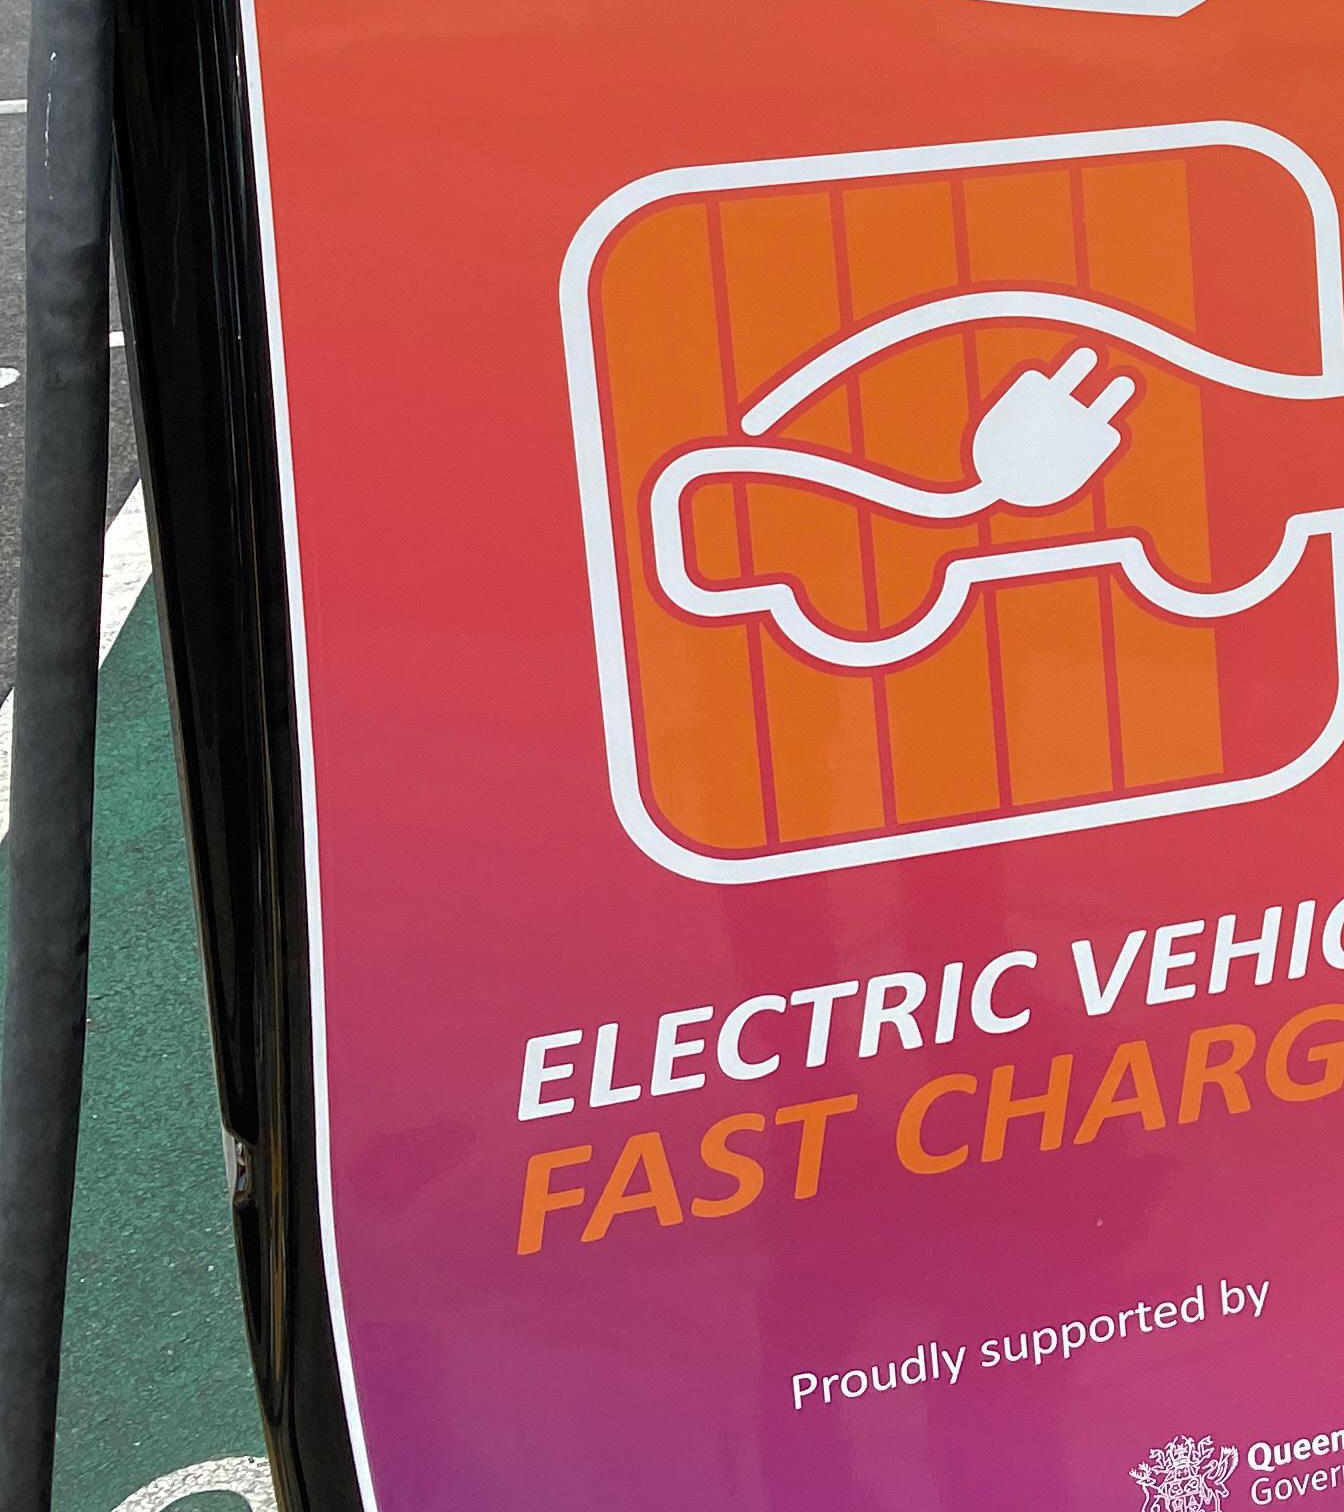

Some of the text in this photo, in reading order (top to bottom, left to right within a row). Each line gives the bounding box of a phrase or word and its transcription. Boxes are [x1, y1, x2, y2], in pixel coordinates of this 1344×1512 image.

[517, 951, 1038, 1121] ELECTRIC
[516, 1094, 858, 1255] FAST
[791, 1279, 1270, 1410] Proudly supported by
